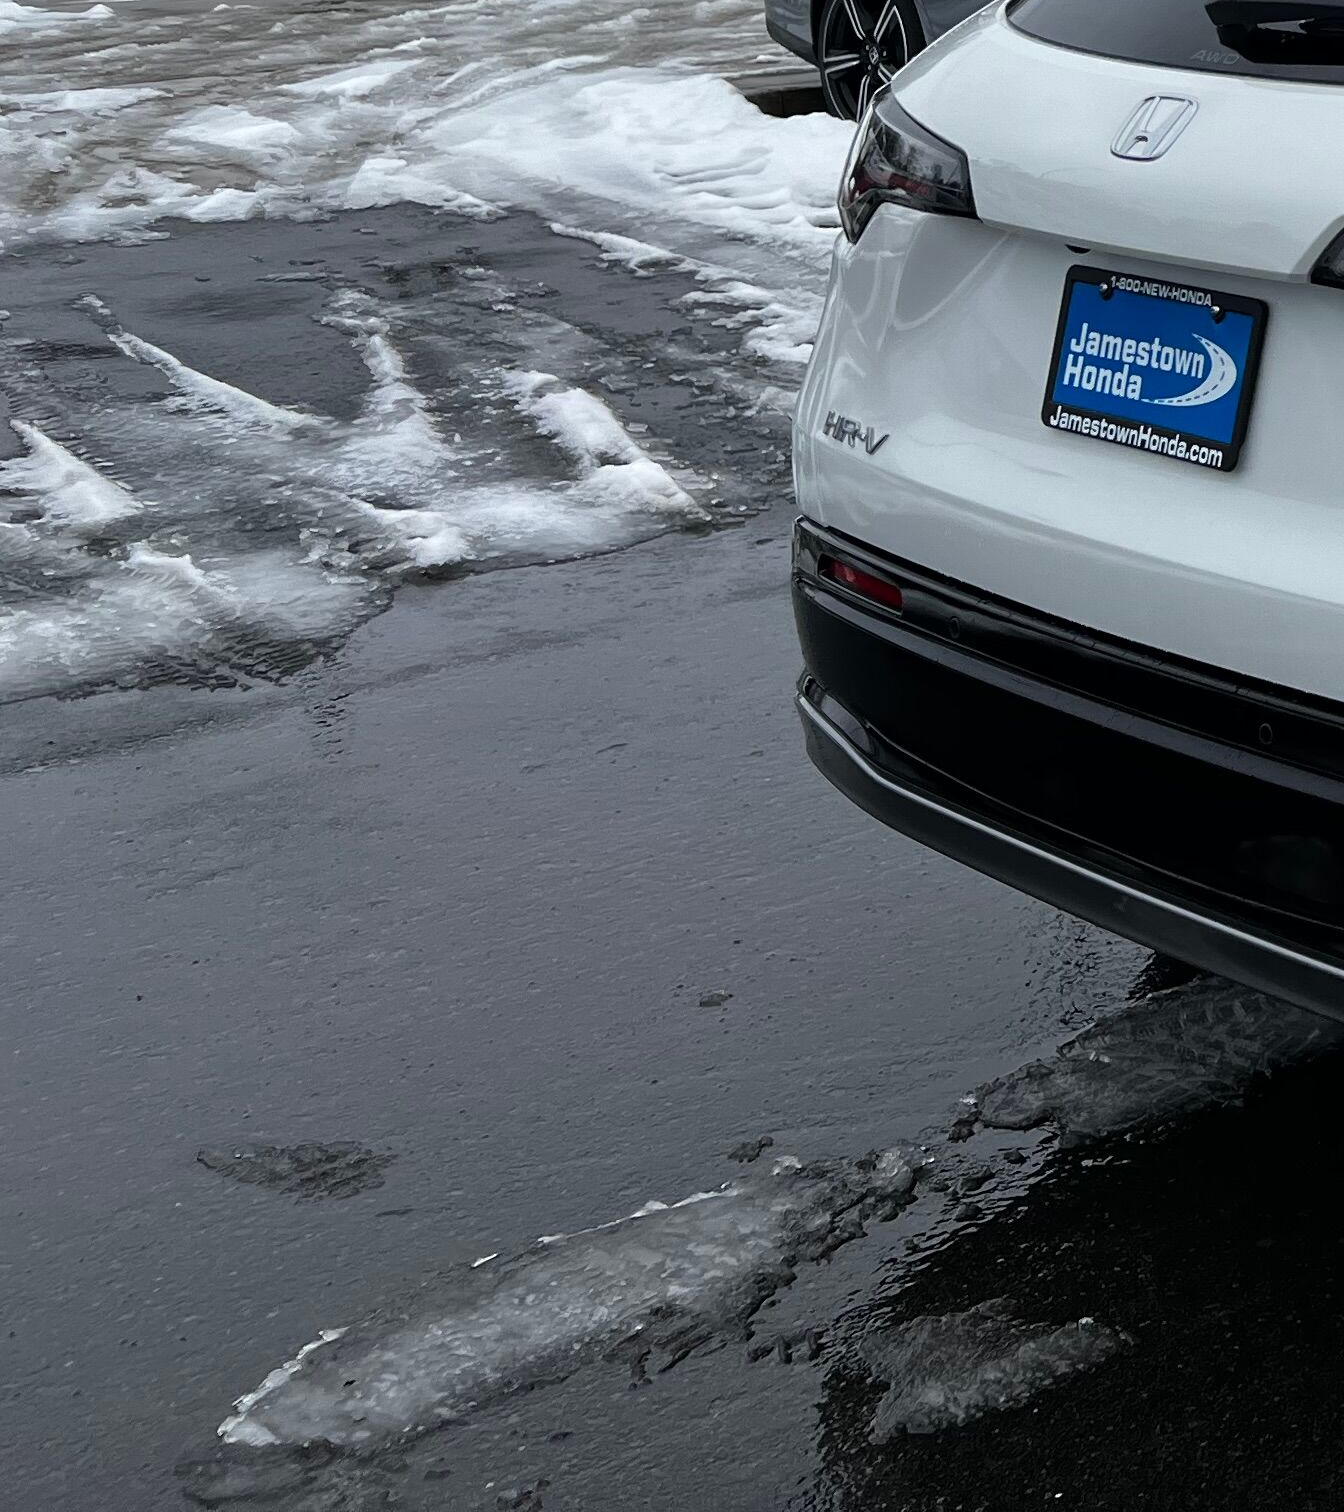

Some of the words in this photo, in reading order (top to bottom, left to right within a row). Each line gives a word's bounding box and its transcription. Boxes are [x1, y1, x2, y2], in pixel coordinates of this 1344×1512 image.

[1190, 49, 1241, 65] AWD
[1110, 275, 1213, 307] 1-800-NEW-HONDA
[1070, 322, 1205, 379] Jamestown
[1062, 353, 1143, 400] Honda
[822, 410, 890, 456] HR-V
[1049, 405, 1224, 467] JamestownHonda.com
